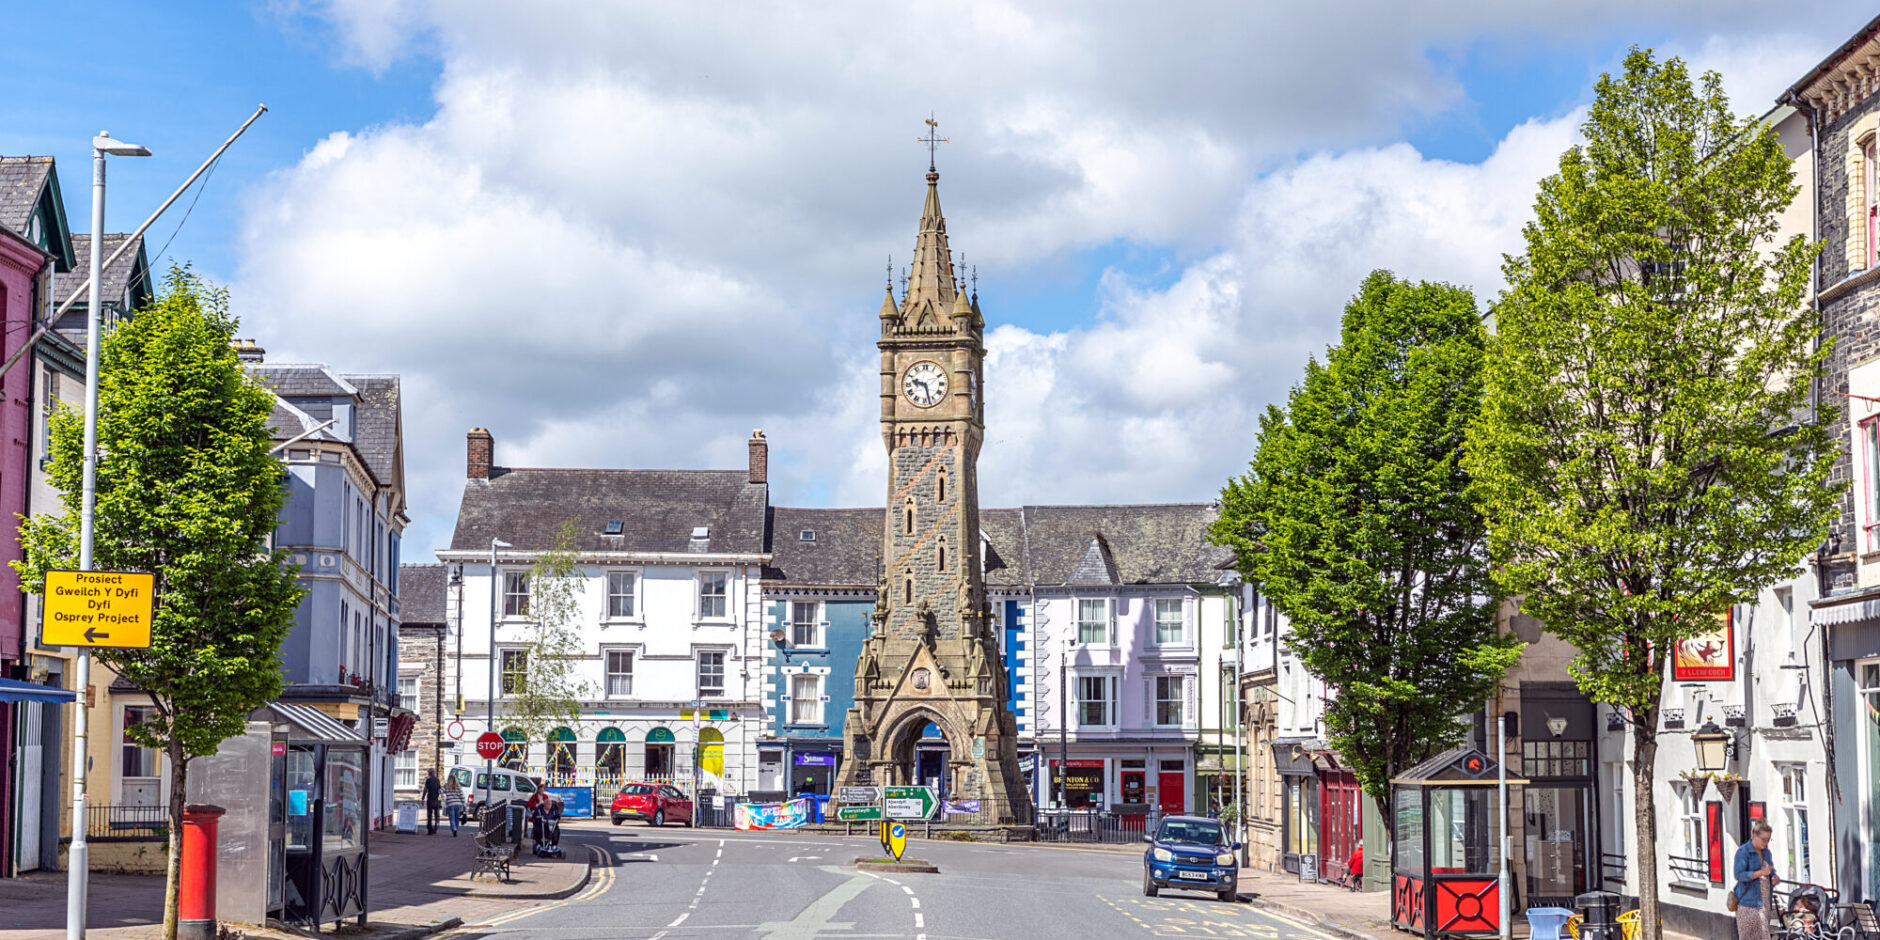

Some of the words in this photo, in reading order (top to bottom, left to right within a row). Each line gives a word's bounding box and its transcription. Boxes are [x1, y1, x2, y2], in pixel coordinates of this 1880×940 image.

[76, 574, 122, 584] Prosiect
[55, 586, 100, 596] Gweilch
[105, 588, 112, 596] Y
[116, 588, 138, 599] Dyfi
[88, 600, 110, 610] Dyfi
[54, 612, 94, 623] Osprey
[98, 613, 139, 624] Project
[478, 741, 503, 750] STOP
